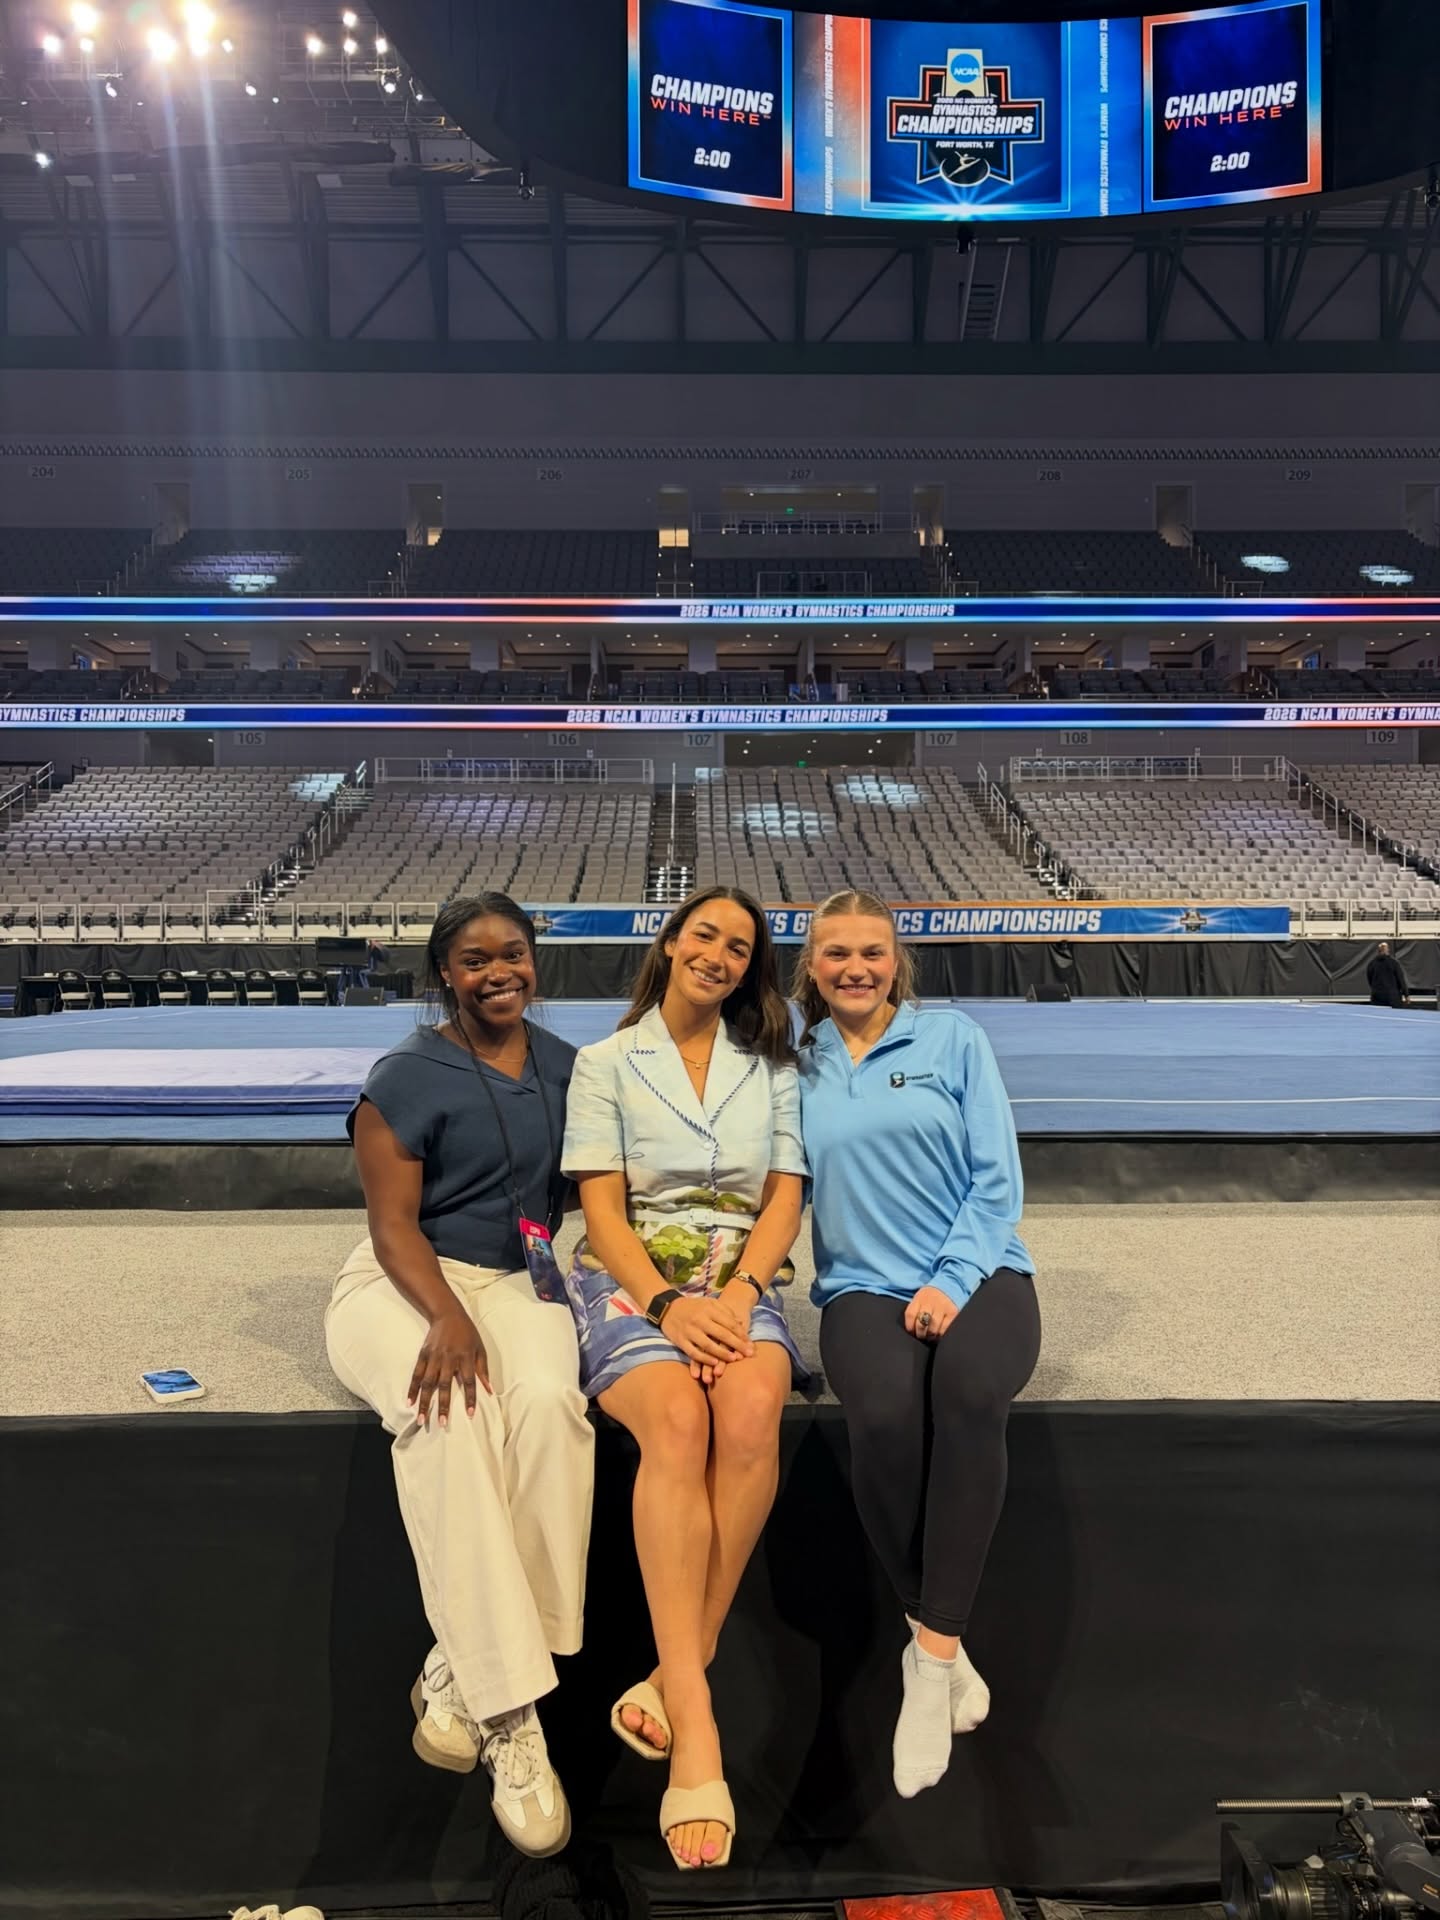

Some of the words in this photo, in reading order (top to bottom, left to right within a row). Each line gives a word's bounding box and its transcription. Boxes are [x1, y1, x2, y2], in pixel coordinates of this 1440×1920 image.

[953, 67, 979, 76] NCAA
[651, 74, 774, 114] CHAMPIONS
[1164, 81, 1297, 118] CHAMPIONS
[650, 97, 691, 115] WIN
[933, 104, 998, 116] GYMNASTICS
[897, 115, 1034, 134] CHAMPIONSHIPS
[1164, 115, 1207, 130] WIN
[693, 147, 731, 168] 2:00
[1210, 151, 1250, 172] 2:00
[287, 469, 310, 480] 205
[540, 470, 562, 480] 206
[790, 469, 811, 479] 207
[1039, 470, 1061, 481] 208
[1288, 469, 1311, 480] 209
[680, 605, 709, 617] 2026
[711, 605, 740, 617] NCAA
[743, 605, 793, 617] WOMEN'S
[796, 605, 863, 617] GYMNASTICS
[866, 604, 955, 616] CHAMPIONSHIPS
[80, 708, 186, 721] CHAMPIONSHIPS
[566, 710, 601, 723] 2026
[604, 710, 636, 723] NCAA
[640, 710, 699, 723] WOMEN'S
[702, 710, 781, 723] GYMNASTICS
[785, 709, 888, 722] CHAMPIONSHIPS
[1263, 708, 1298, 721] 2026
[1301, 708, 1332, 721] NCAA
[1337, 708, 1395, 720] WOMEN'S
[238, 732, 262, 744] 105
[551, 733, 577, 745] 106
[687, 734, 712, 745] 107
[929, 733, 954, 744] 107
[1064, 732, 1088, 744] 108
[1371, 731, 1395, 743] 109
[928, 909, 1101, 933] CHAMPIONSHIPS
